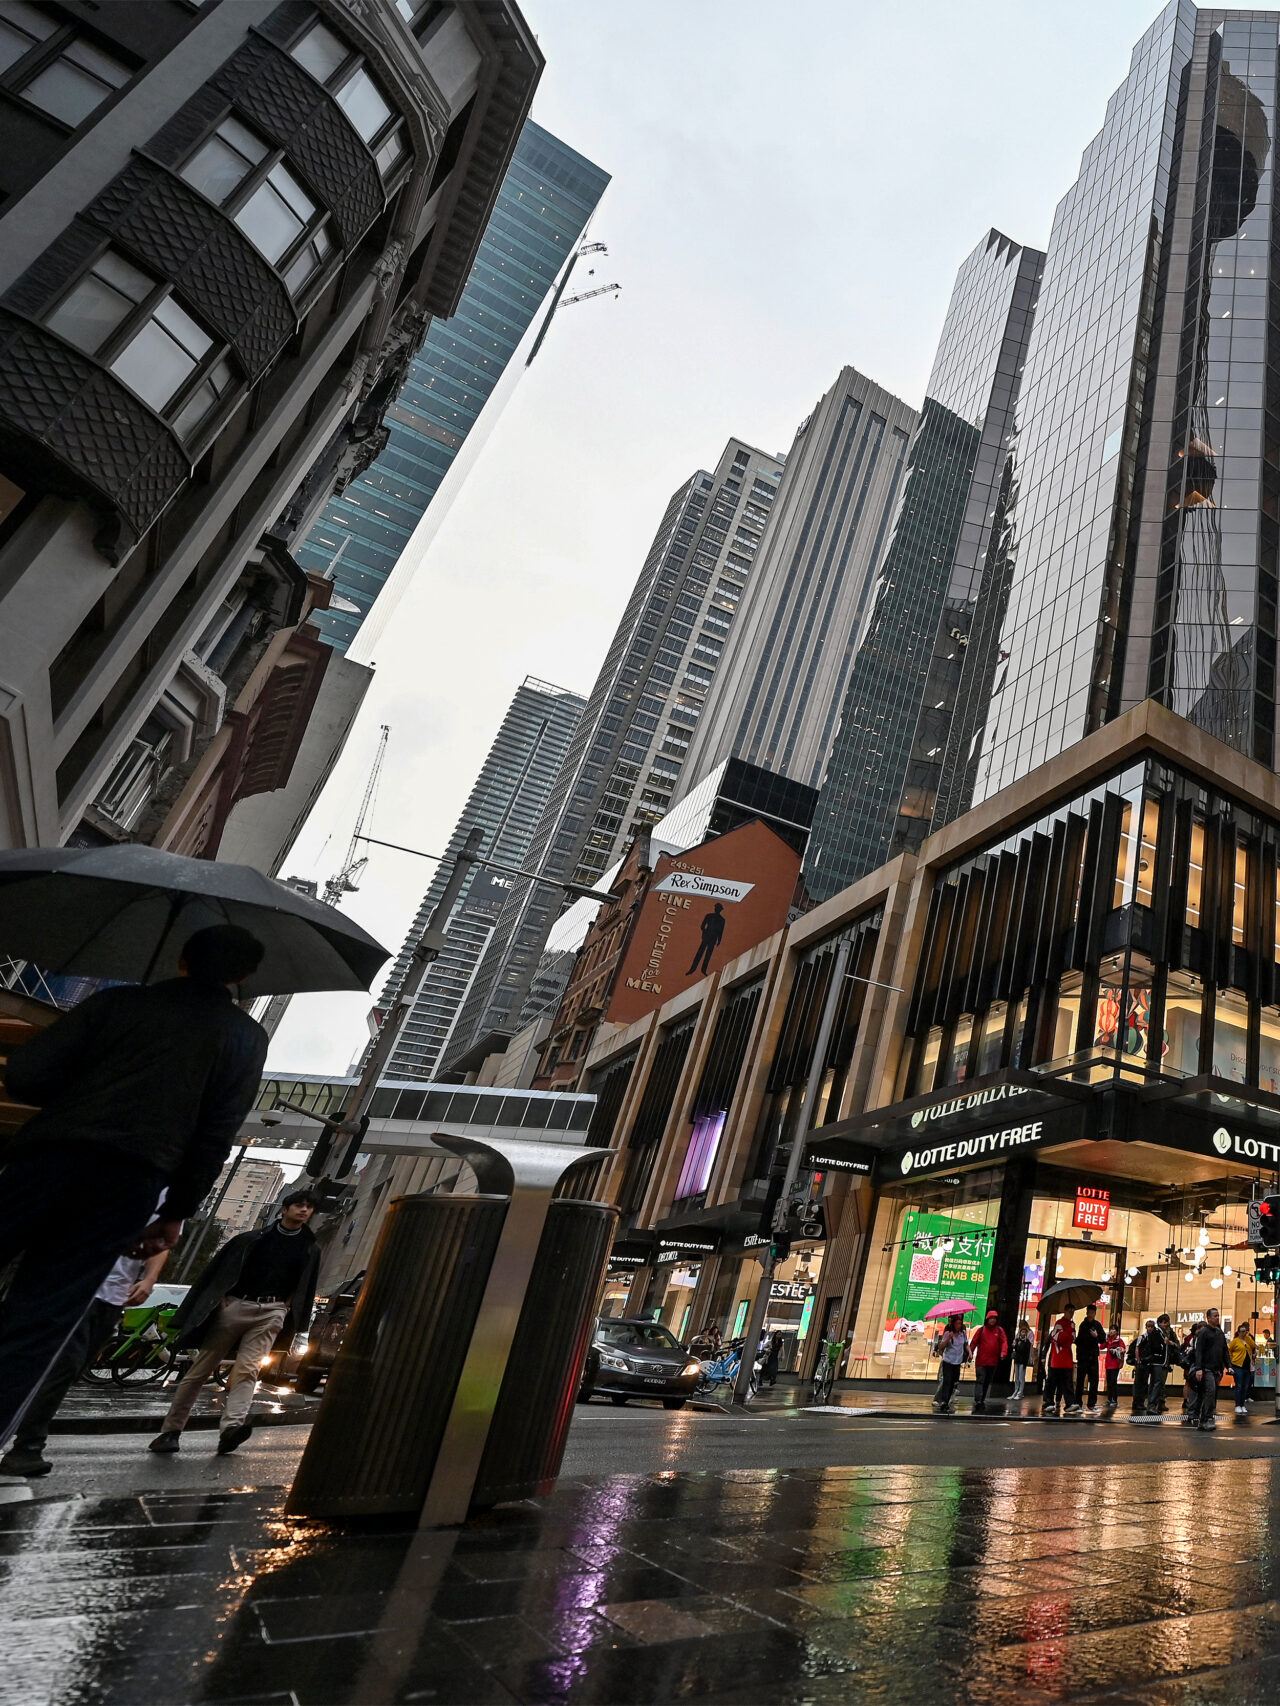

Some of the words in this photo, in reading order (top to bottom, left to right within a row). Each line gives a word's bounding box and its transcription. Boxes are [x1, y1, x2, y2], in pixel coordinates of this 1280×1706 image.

[670, 860, 704, 875] 249-251
[671, 874, 690, 888] Rex
[692, 877, 740, 897] Simpson
[659, 892, 692, 909] FINE
[649, 907, 677, 968] CLOTHES
[641, 968, 660, 980] for
[626, 977, 662, 994] MEN
[914, 1144, 957, 1169] LOTTE
[957, 1132, 1000, 1158] DUTY
[1000, 1121, 1043, 1148] FREE
[816, 1157, 835, 1165] LOTTE
[836, 1160, 853, 1168] DUTY
[1077, 1186, 1110, 1200] LOTTE
[1079, 1202, 1107, 1215] DUTY
[1077, 1213, 1105, 1226] FREE
[943, 1270, 968, 1281] RMB
[971, 1272, 984, 1282] 88
[1177, 1313, 1187, 1322] LA
[1188, 1312, 1205, 1322] MER
